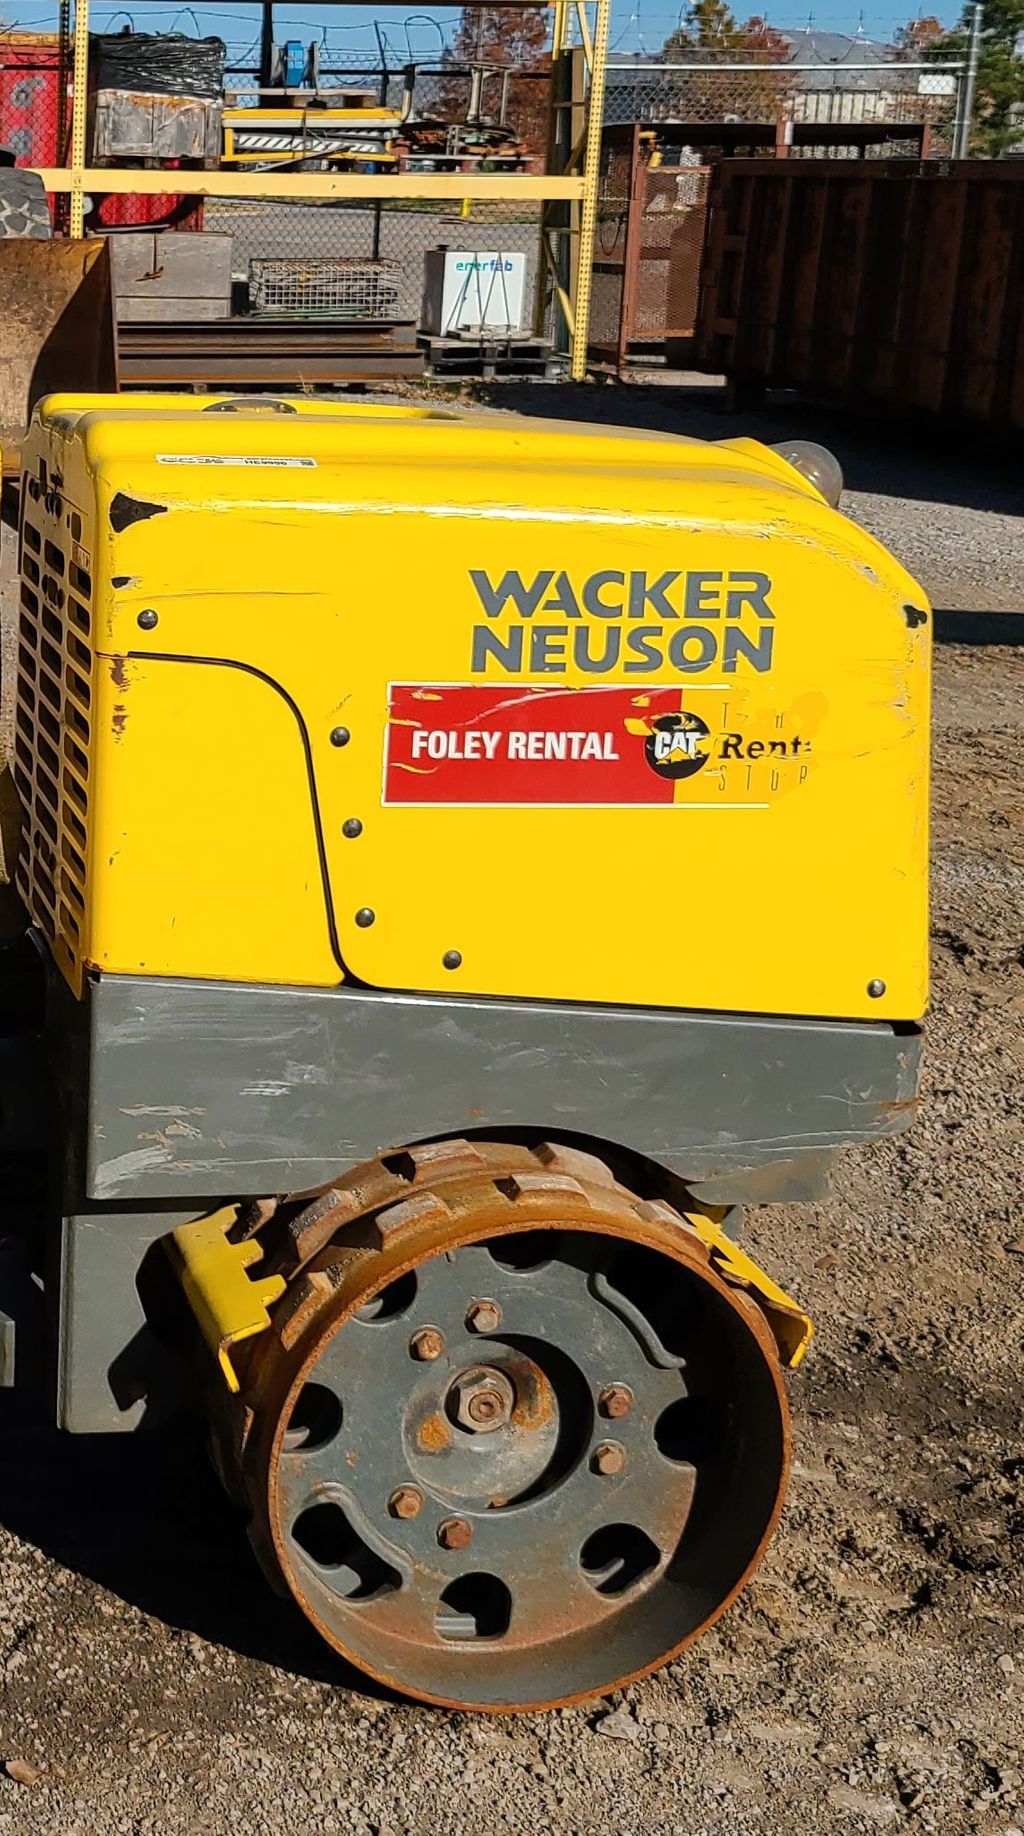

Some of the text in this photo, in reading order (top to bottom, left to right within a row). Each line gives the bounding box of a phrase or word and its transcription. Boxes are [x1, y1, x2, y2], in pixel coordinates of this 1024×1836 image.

[456, 259, 513, 271] enerfab
[468, 569, 776, 619] WACKER
[471, 624, 775, 674] NEUSON
[411, 730, 619, 761] FOLEY RENTAL
[654, 731, 704, 760] CAT
